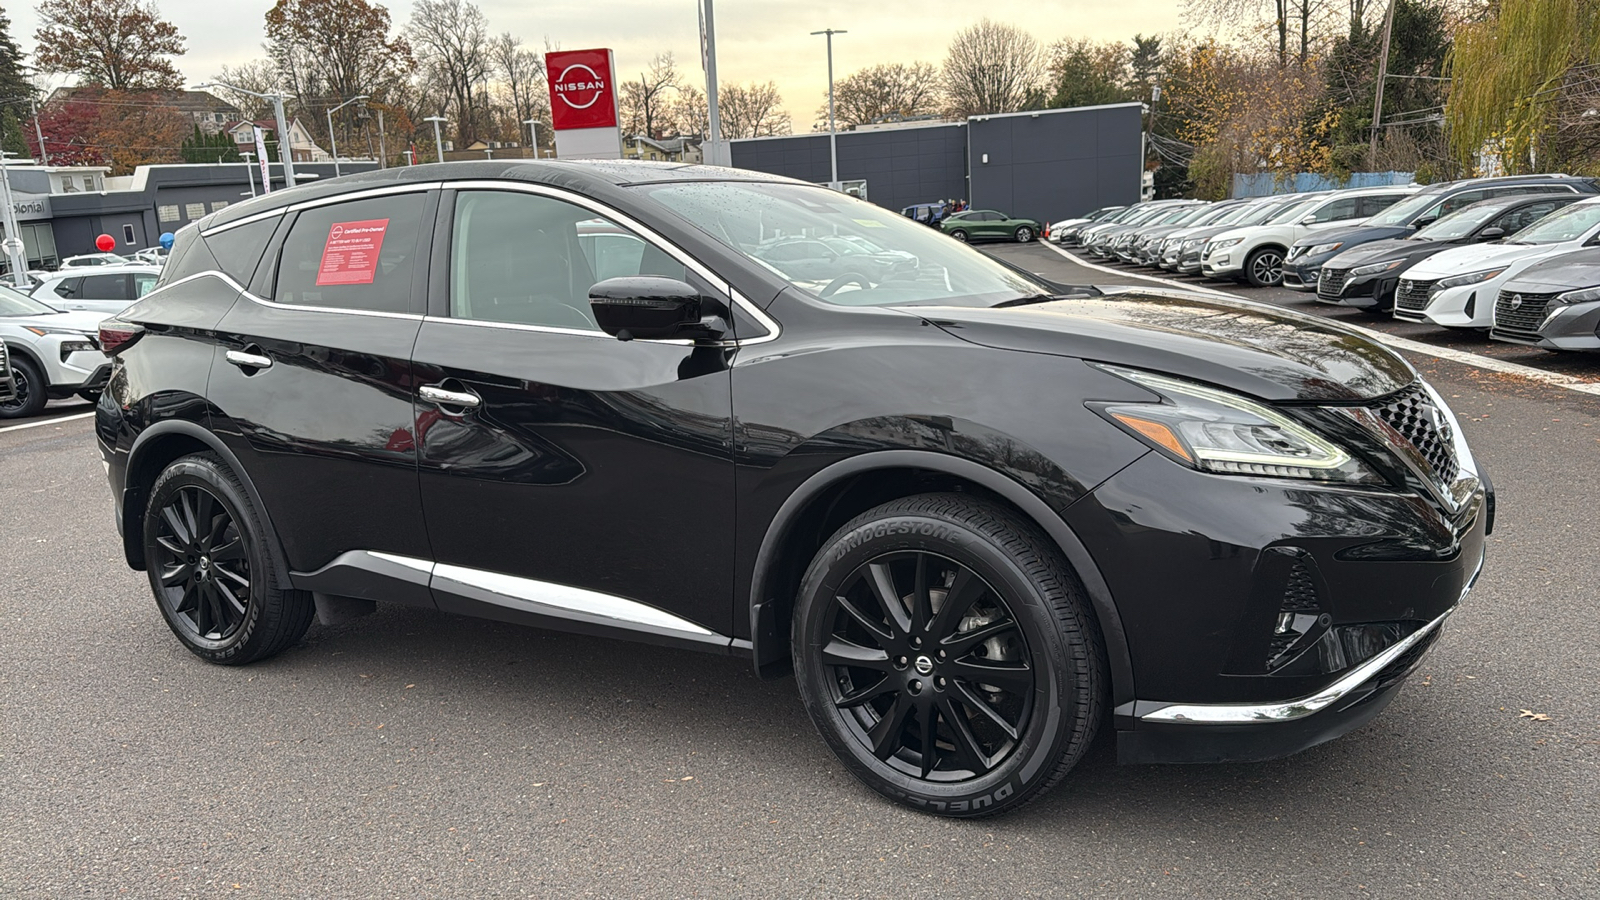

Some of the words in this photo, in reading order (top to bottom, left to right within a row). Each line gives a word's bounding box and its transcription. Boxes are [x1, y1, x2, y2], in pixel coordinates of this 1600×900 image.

[555, 81, 604, 92] NISSAN
[834, 521, 961, 560] BRIDGESTONE
[215, 603, 259, 659] DUELER
